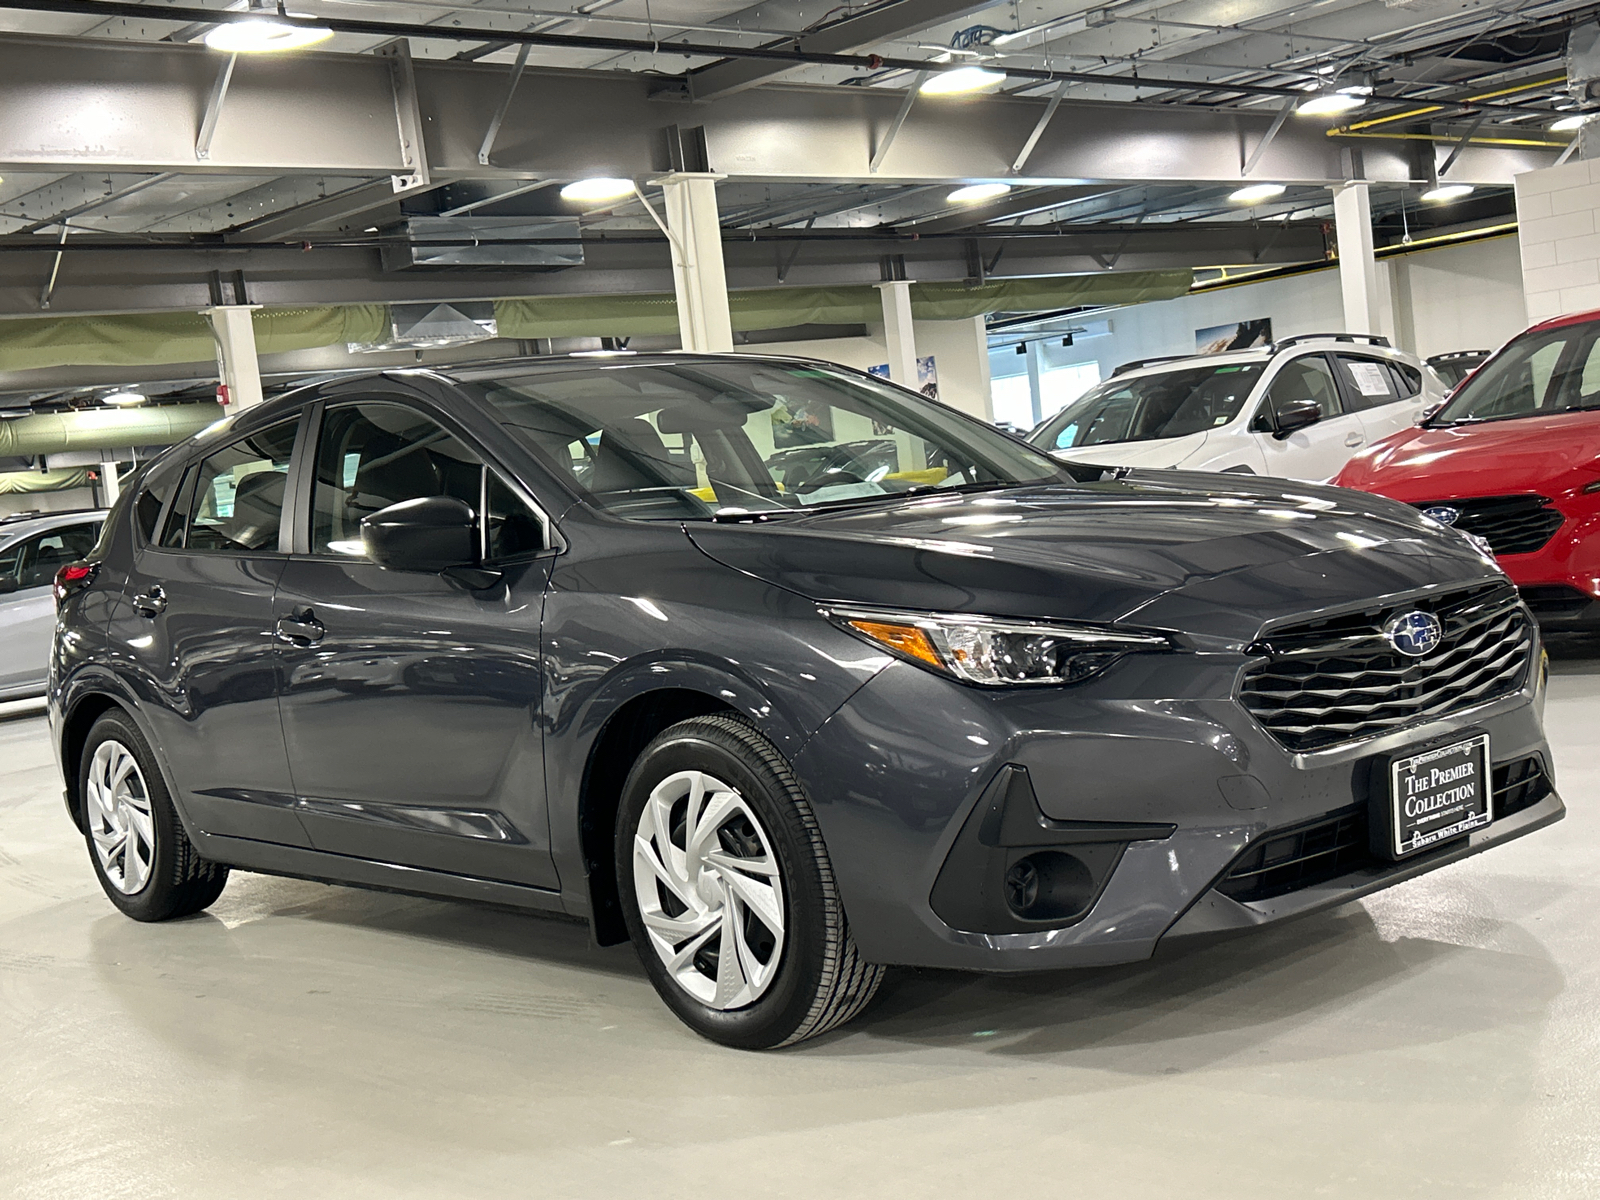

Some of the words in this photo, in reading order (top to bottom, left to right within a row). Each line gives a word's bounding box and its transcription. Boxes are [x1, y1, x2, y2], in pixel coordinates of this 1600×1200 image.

[1405, 775, 1429, 796] THE
[1430, 762, 1475, 788] PREMIER
[1405, 782, 1475, 818] COLLECTION
[1438, 826, 1458, 840] White
